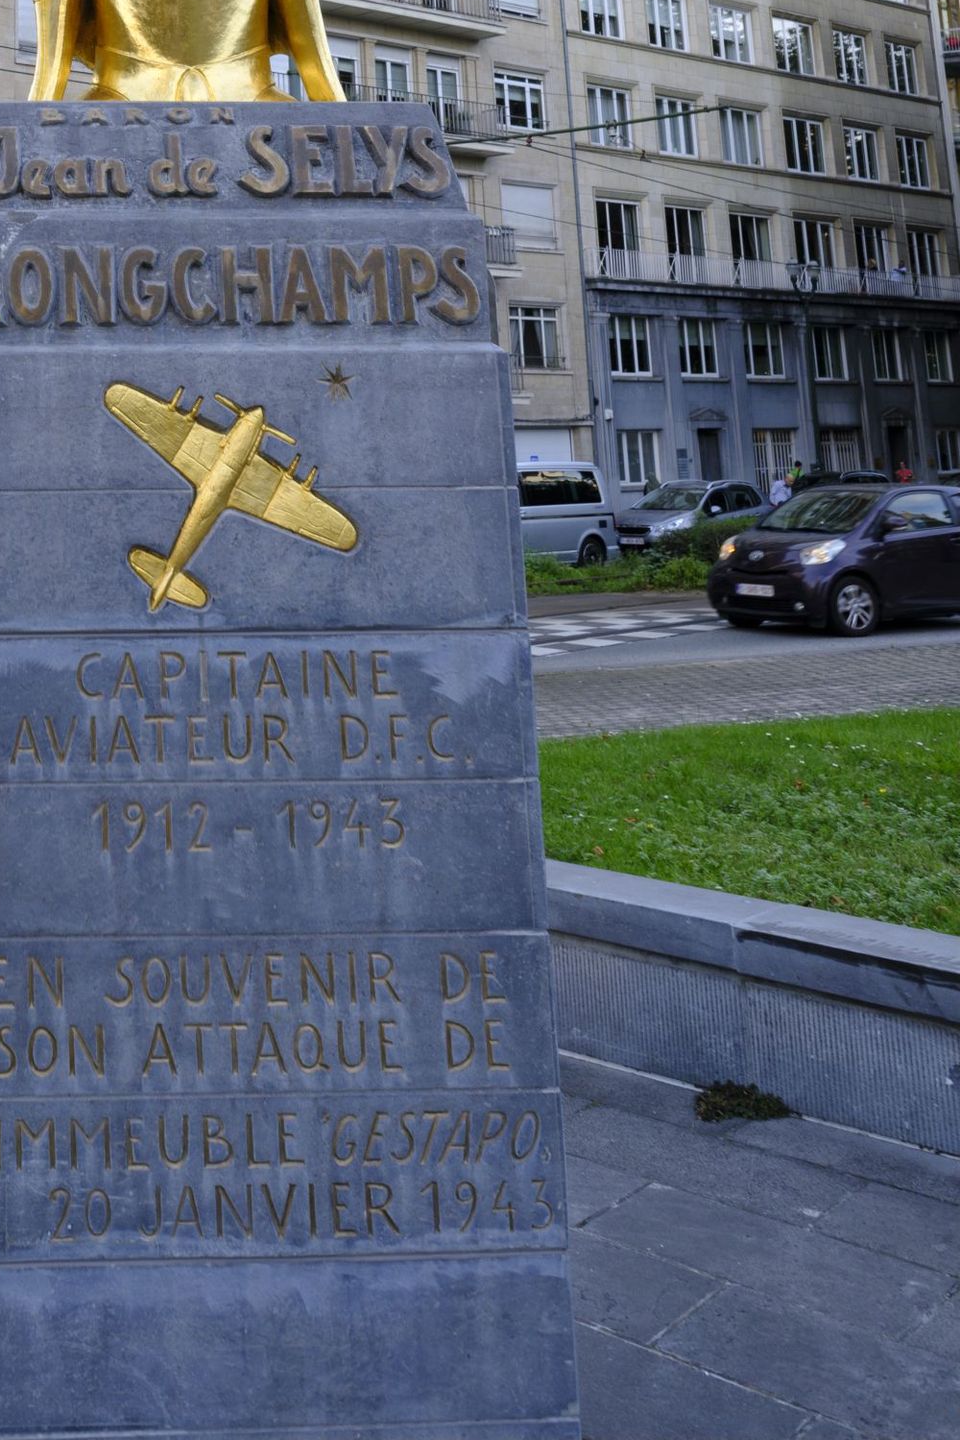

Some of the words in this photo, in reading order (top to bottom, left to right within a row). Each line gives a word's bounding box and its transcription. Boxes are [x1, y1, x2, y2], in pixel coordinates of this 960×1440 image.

[40, 108, 234, 126] BARON
[148, 134, 219, 198] de
[240, 124, 452, 200] SELYS
[75, 649, 400, 702] CAPITAINE
[9, 714, 295, 765] AVIATEUR
[339, 714, 475, 765] D.F.C.
[93, 801, 213, 852] 1912
[277, 798, 407, 850] 1943
[104, 953, 403, 1008] SOUVENIR
[440, 951, 508, 1004] DE
[142, 1019, 405, 1078] ATTAQUE
[445, 1019, 511, 1072] DE
[49, 1187, 113, 1244] 20
[140, 1180, 405, 1241] JANVIER
[418, 1178, 555, 1234] 1943
